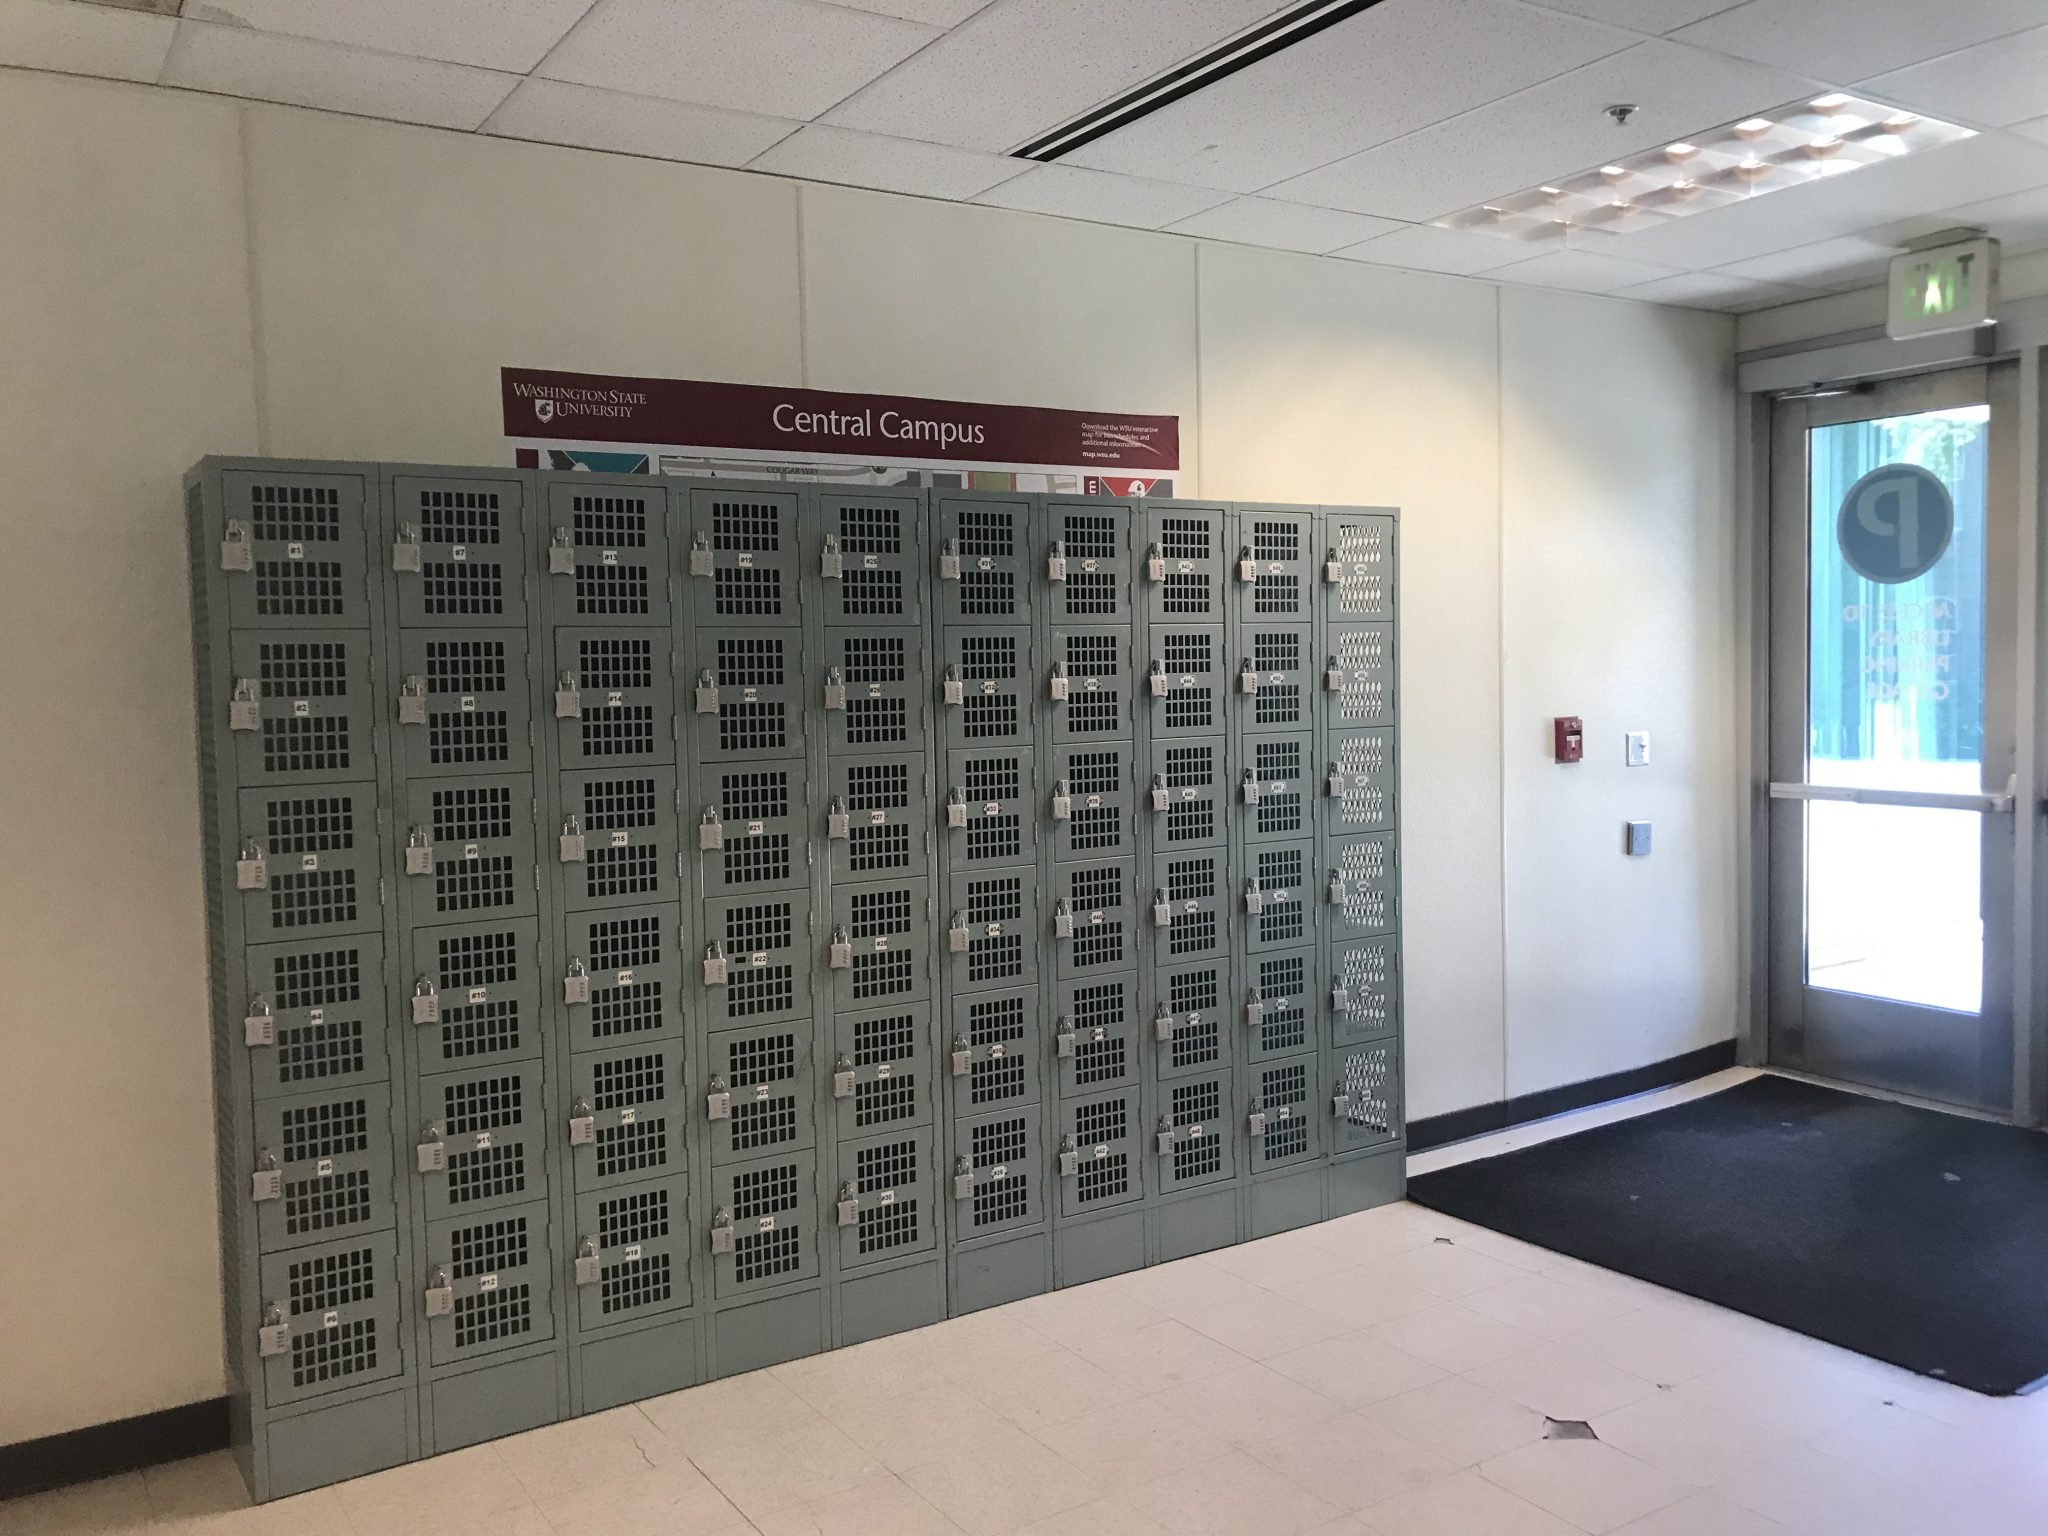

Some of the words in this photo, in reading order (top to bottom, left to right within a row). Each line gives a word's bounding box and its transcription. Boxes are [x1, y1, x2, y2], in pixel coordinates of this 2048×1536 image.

[513, 382, 607, 402] WASHINGTON
[609, 389, 647, 405] STATE
[556, 402, 633, 418] UNIVERSITY
[772, 403, 872, 437] Central
[879, 411, 985, 450] Campus
[1081, 422, 1109, 431] Download
[1109, 423, 1118, 431] the
[1132, 425, 1159, 433] interactive
[1082, 438, 1109, 447] additional
[1082, 451, 1121, 459] map.wsu.edu
[766, 465, 800, 475] COUGAR
[801, 467, 819, 475] WAY
[1088, 480, 1097, 494] E
[463, 699, 474, 707] #8
[296, 704, 307, 712] #2
[467, 847, 477, 855] #9
[619, 973, 633, 981] #16
[471, 991, 486, 999] #10
[756, 1088, 768, 1096] #23
[476, 1136, 490, 1144] #11
[481, 1278, 496, 1286] #12
